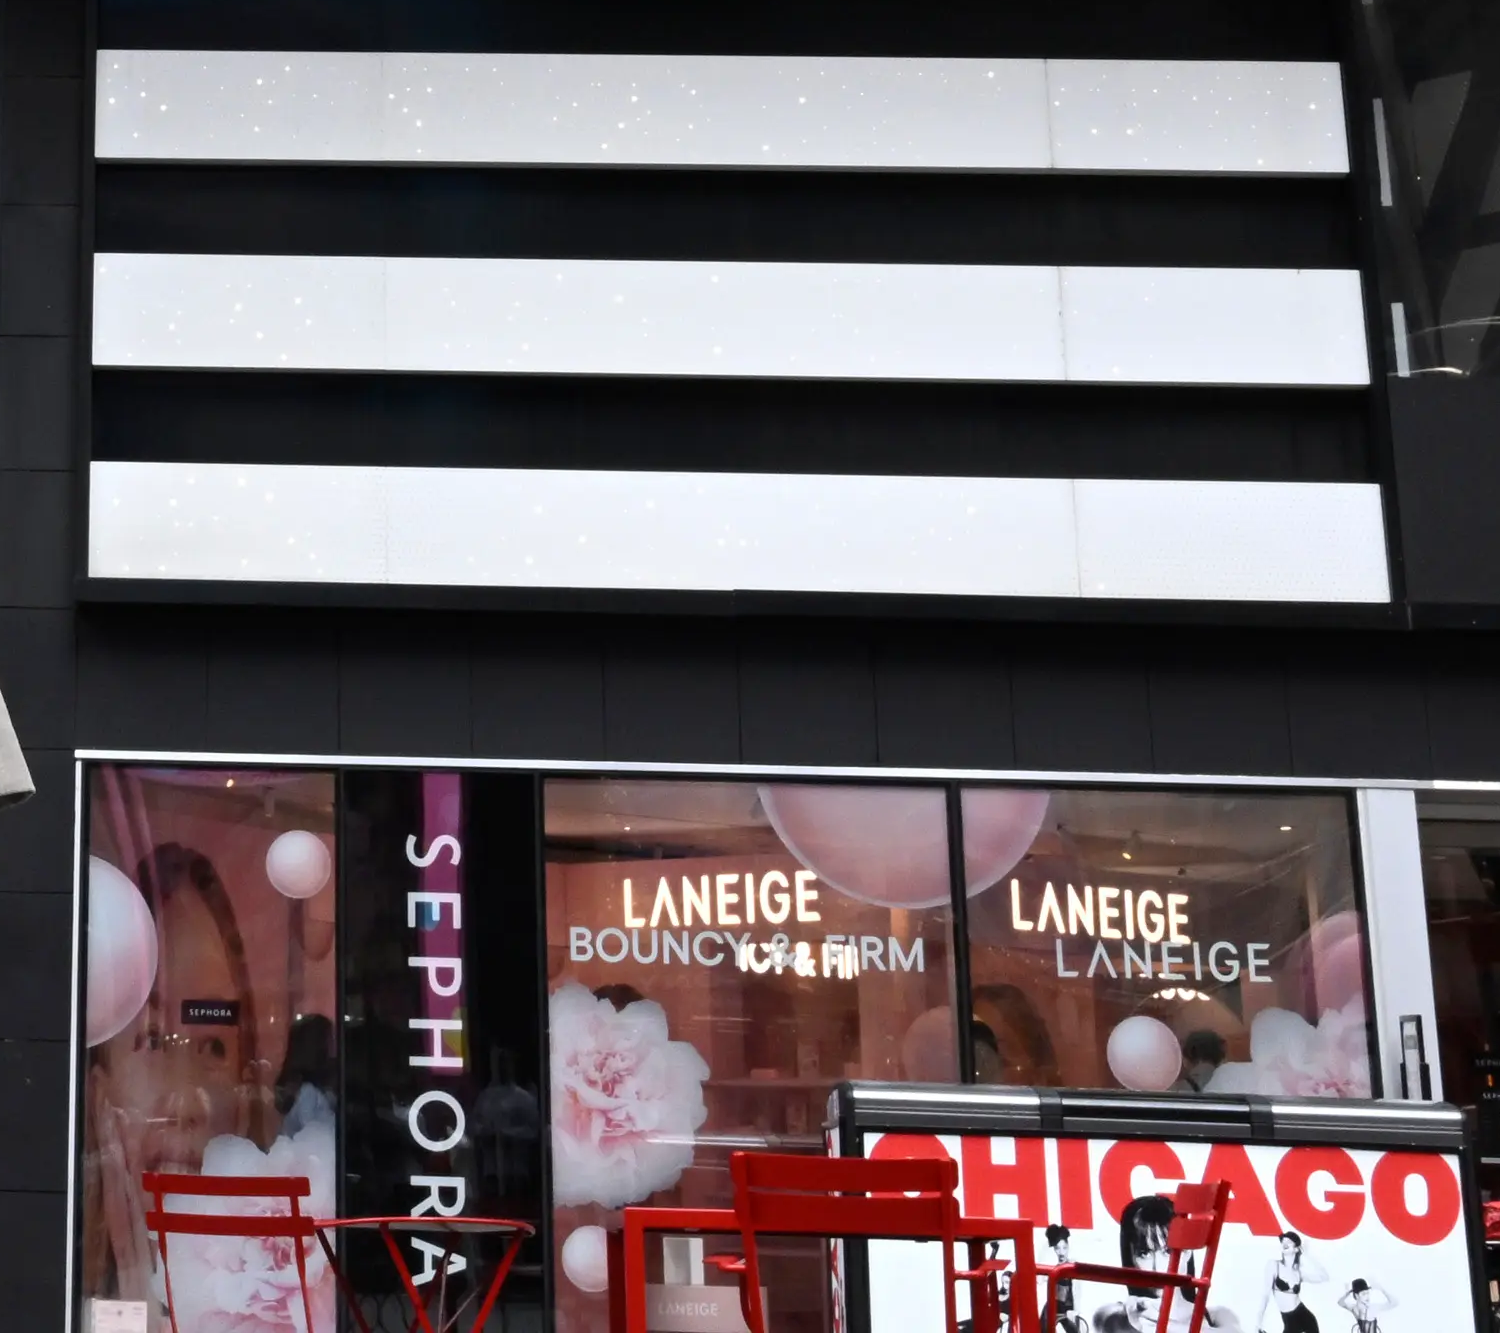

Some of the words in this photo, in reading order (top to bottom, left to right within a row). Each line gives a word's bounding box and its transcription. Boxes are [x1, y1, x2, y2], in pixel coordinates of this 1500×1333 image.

[622, 870, 822, 928] LANEIGE
[1010, 878, 1192, 945] LANEIGE
[569, 926, 751, 967] BOUNCY
[824, 933, 926, 973] FIRM
[1055, 938, 1274, 983] LANEIGE
[188, 1008, 232, 1017] SEPHORA
[406, 833, 467, 1287] SEPHORA
[658, 1301, 719, 1317] LANEIGE
